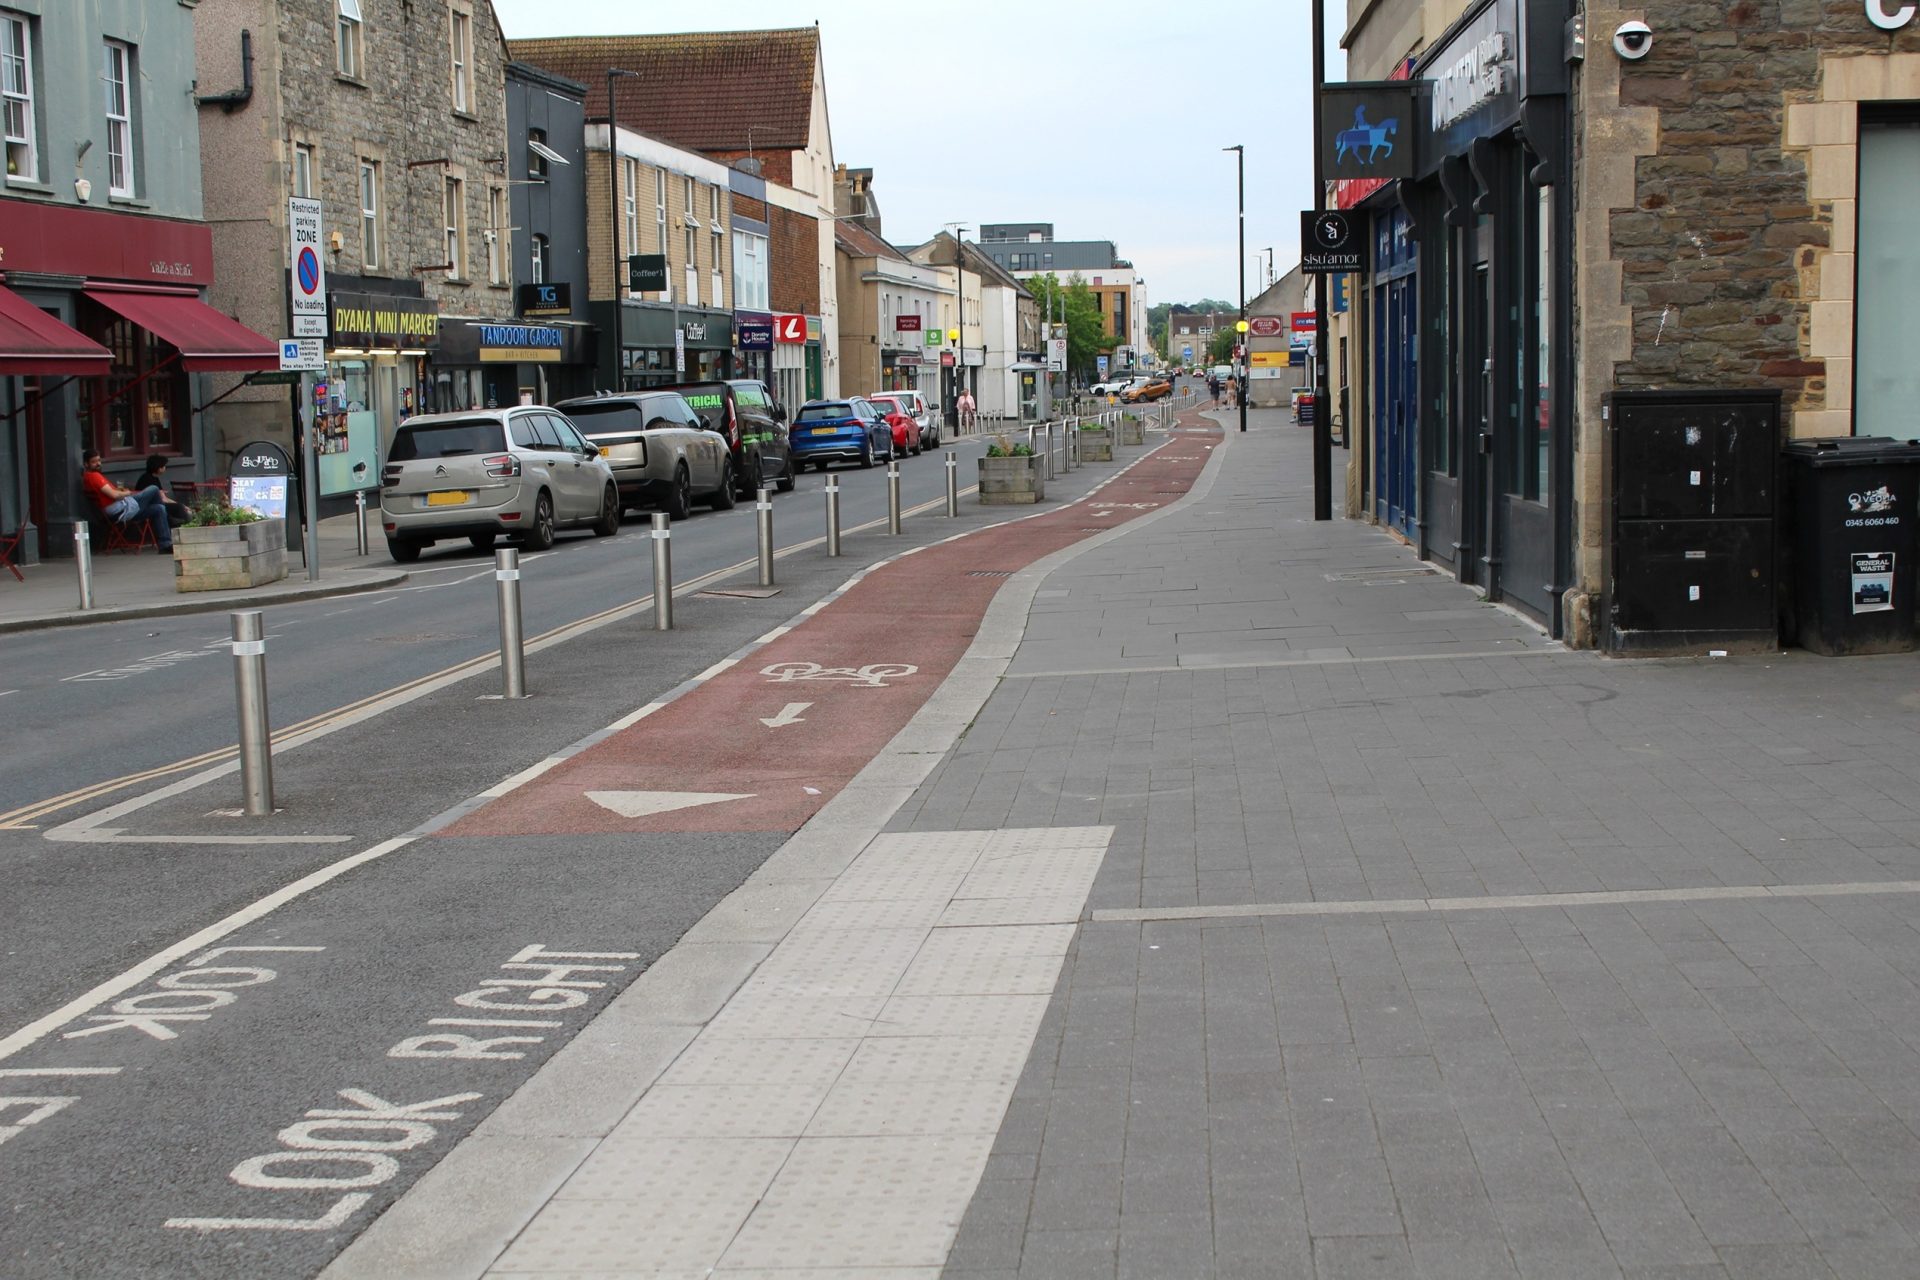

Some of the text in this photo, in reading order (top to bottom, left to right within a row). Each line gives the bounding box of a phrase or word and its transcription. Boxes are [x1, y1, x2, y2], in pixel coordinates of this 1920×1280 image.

[292, 201, 320, 215] Restricted
[296, 217, 317, 228] parking
[296, 230, 317, 243] ZONE
[537, 286, 557, 302] TG
[294, 299, 325, 311] No loading
[335, 308, 439, 336] DYANA MINI MARKET
[480, 326, 563, 346] TANDOORI GARDEN
[504, 350, 515, 359] BAR
[519, 350, 539, 359] KITCHEN
[683, 395, 722, 408] TRICAL
[1845, 517, 1900, 527] 0345 6060 460
[1855, 559, 1890, 567] GENERAL
[62, 945, 327, 1041] LOOK
[164, 1087, 484, 1231] LOOK
[387, 943, 641, 1061] RIGHT
